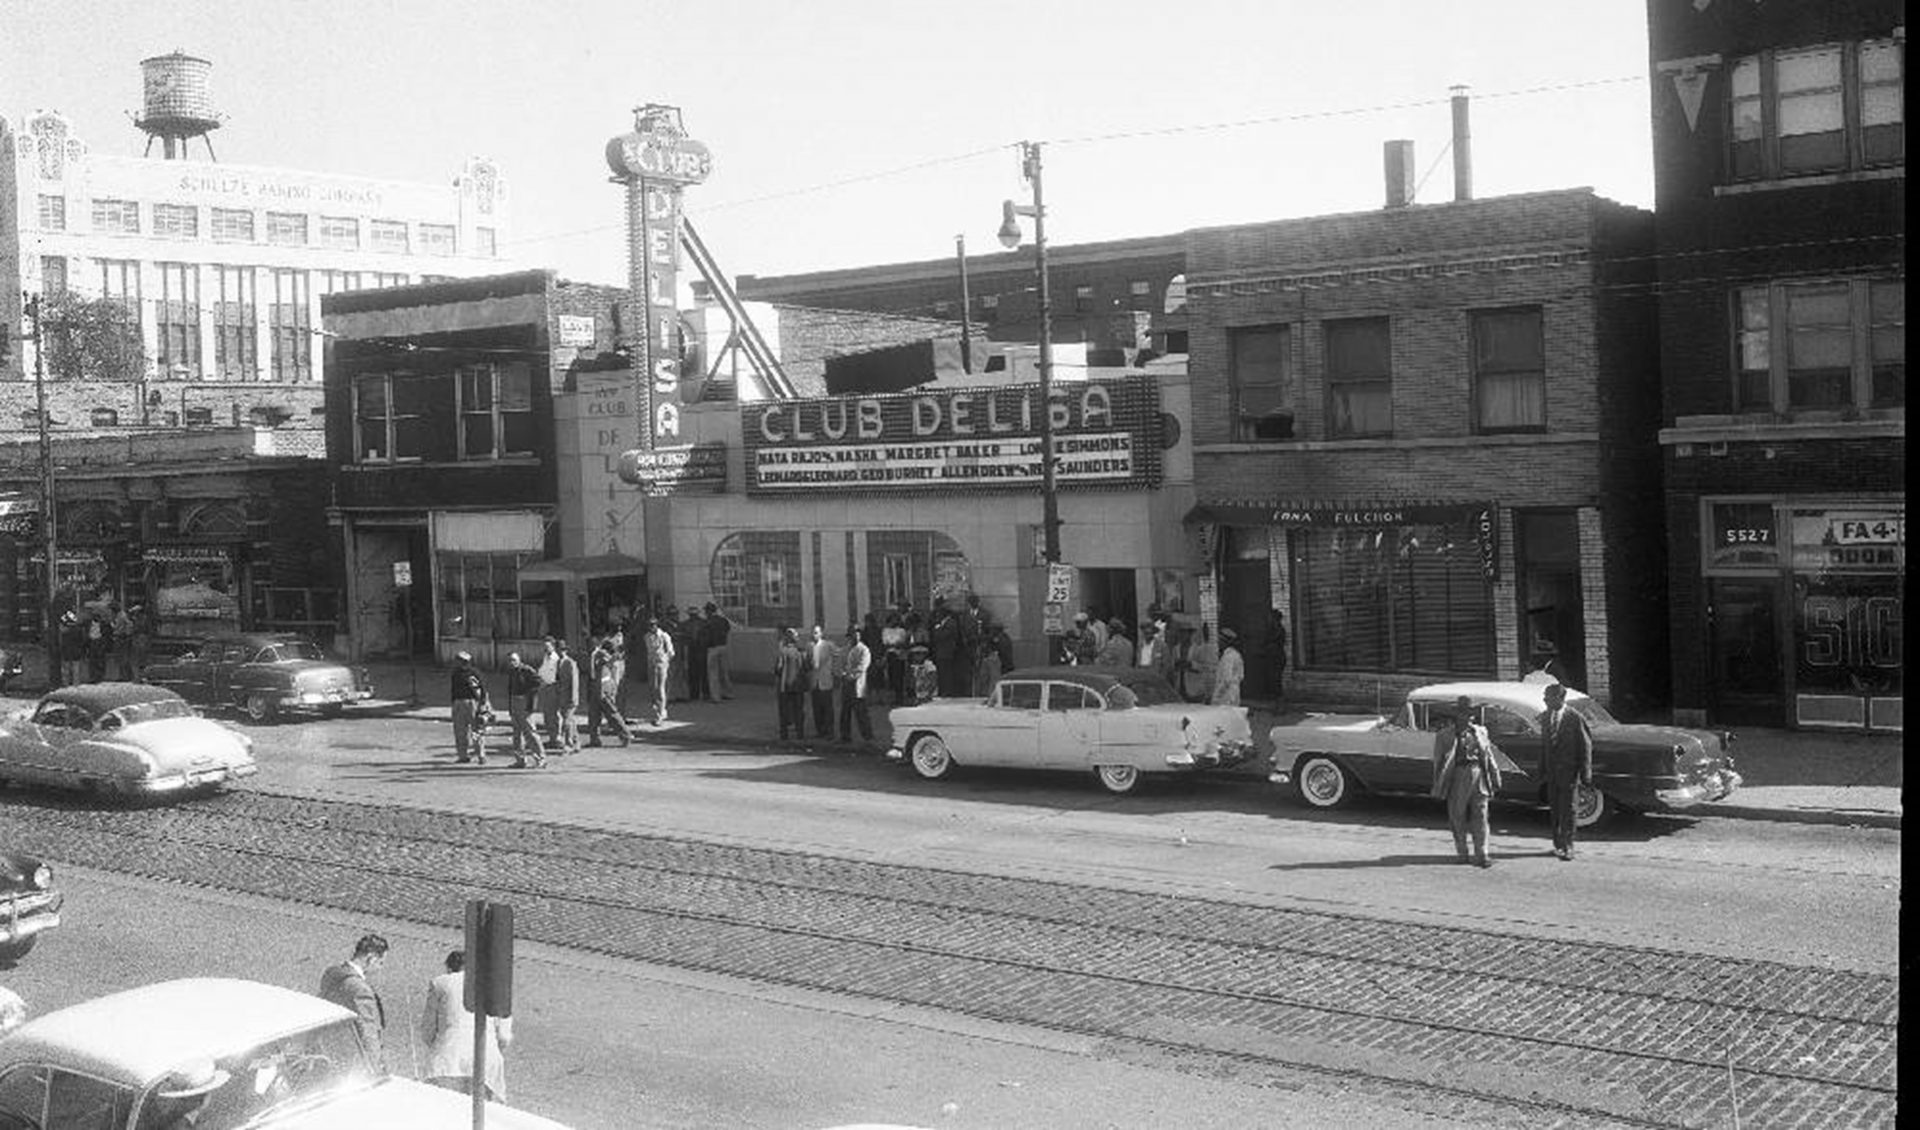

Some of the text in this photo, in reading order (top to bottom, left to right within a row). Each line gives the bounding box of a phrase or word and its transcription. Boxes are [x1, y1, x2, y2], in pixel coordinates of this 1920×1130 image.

[759, 399, 884, 443] CLUB
[1056, 458, 1130, 475] SAUNDERS
[1726, 529, 1769, 542] 5527
[1052, 586, 1067, 600] 25
